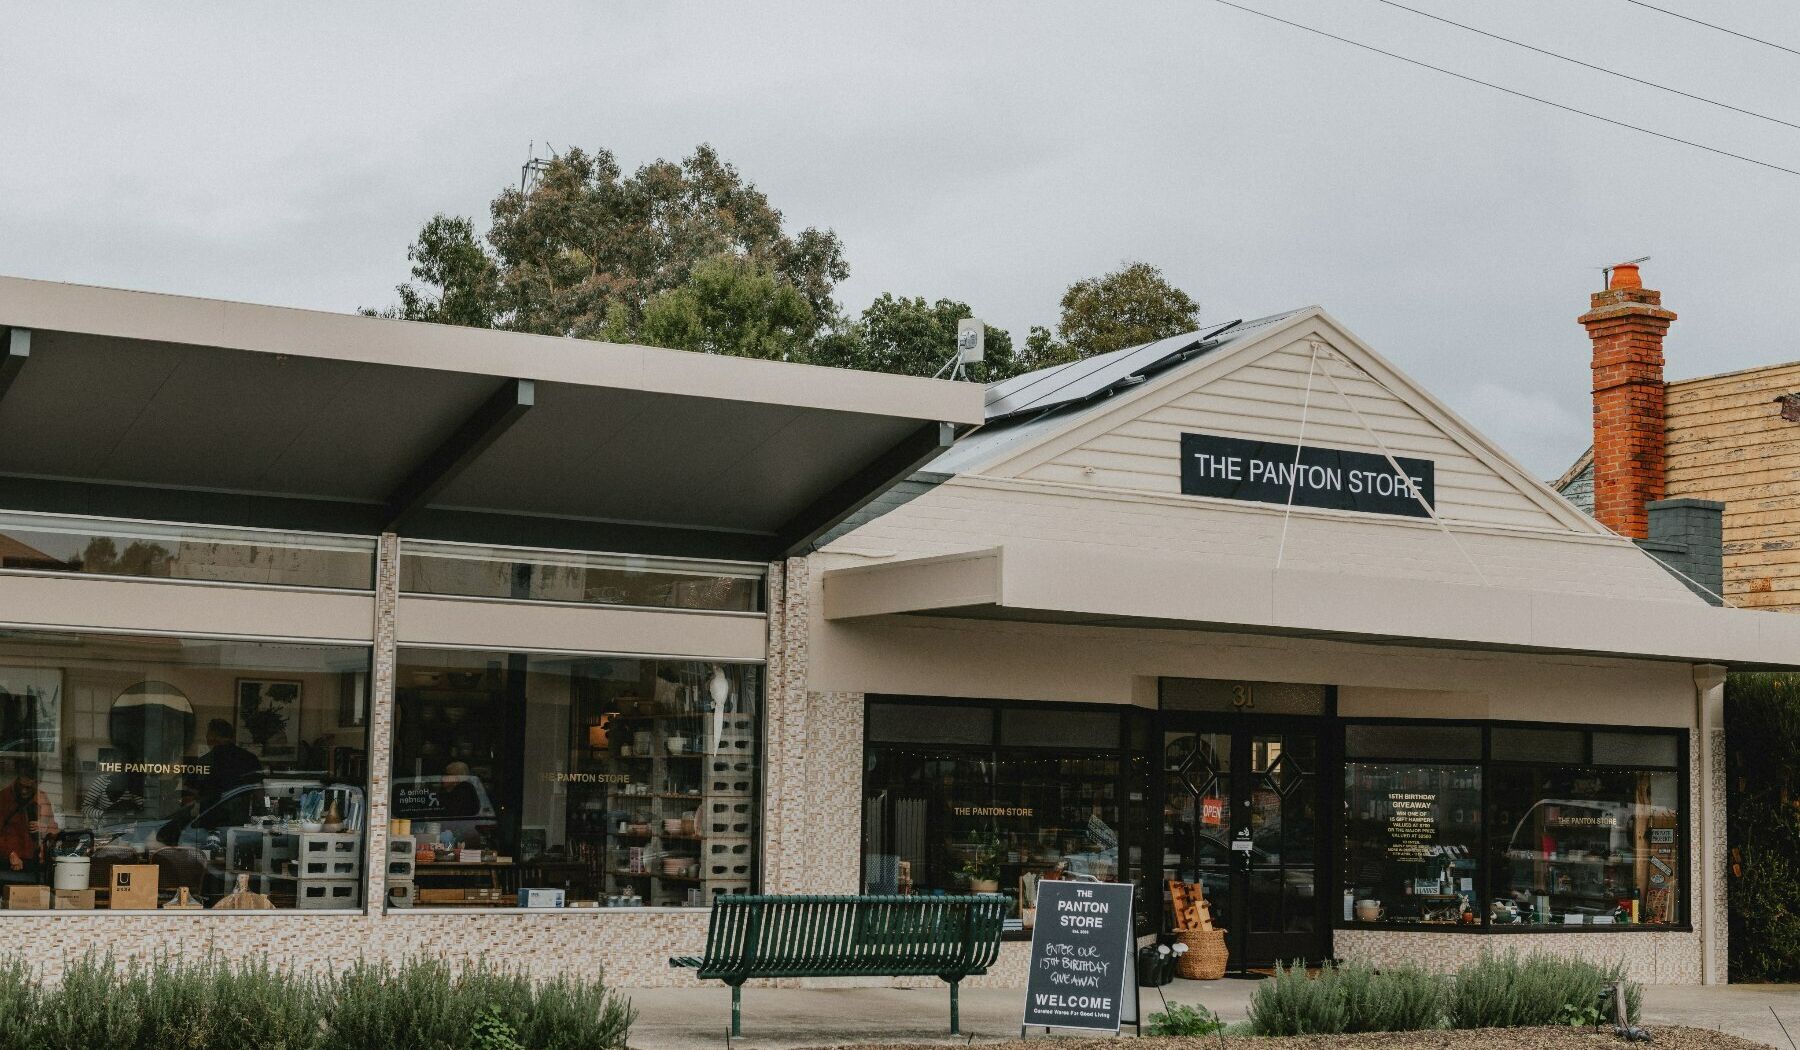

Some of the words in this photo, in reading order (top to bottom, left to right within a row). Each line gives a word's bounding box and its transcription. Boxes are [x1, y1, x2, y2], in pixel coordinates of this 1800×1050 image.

[1194, 453, 1242, 481] THE
[1249, 459, 1342, 491] PANTON
[1348, 470, 1423, 499] STORE
[1232, 685, 1255, 708] 31
[99, 762, 122, 772] THE
[125, 763, 170, 774] PANTON
[173, 764, 211, 775] STORE
[557, 773, 596, 783] PANTON
[597, 774, 630, 783] STORE
[1203, 804, 1222, 819] OPEN
[1392, 801, 1431, 809] GIVEAWAY
[954, 807, 971, 816] THE
[972, 807, 1005, 816] PANTON
[1006, 808, 1033, 817] STORE
[1557, 817, 1571, 825] THE
[1571, 817, 1596, 825] PANTON
[1596, 817, 1617, 826] STORE
[1076, 889, 1093, 898] THE
[1057, 900, 1109, 914] PANTON
[1060, 915, 1103, 928] STORE
[1045, 942, 1075, 956] ENTER
[1077, 945, 1100, 958] OUR
[1061, 958, 1110, 977] BIRTHDAY
[1050, 971, 1100, 988] GIVEAWAY
[1035, 993, 1112, 1010] WELCOME
[1079, 1010, 1094, 1018] Good
[1094, 1011, 1110, 1019] Living
